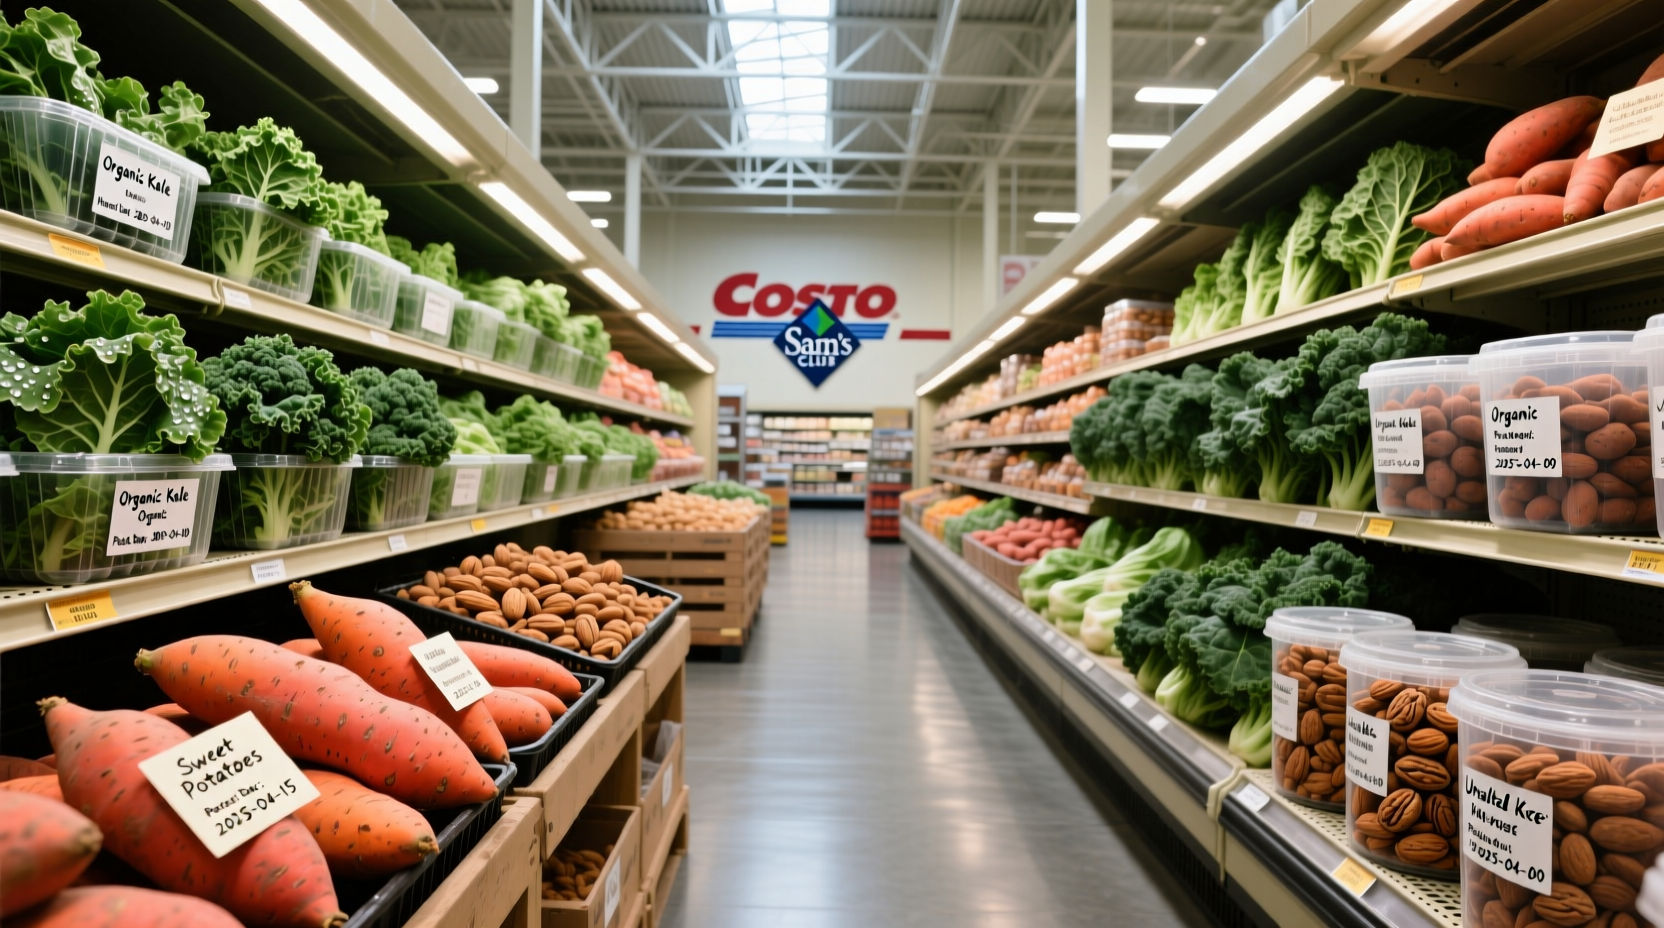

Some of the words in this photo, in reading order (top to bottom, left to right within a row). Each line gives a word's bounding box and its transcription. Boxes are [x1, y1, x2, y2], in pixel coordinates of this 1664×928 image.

[103, 155, 144, 185] Organic
[147, 173, 171, 197] Kale
[784, 326, 853, 357] Sam's
[1491, 405, 1538, 428] Organic
[119, 488, 162, 511] Organic
[166, 486, 189, 504] Kale
[177, 738, 234, 776] Sweet
[181, 750, 263, 800] Potatoes
[215, 778, 297, 837] 2025-04-15
